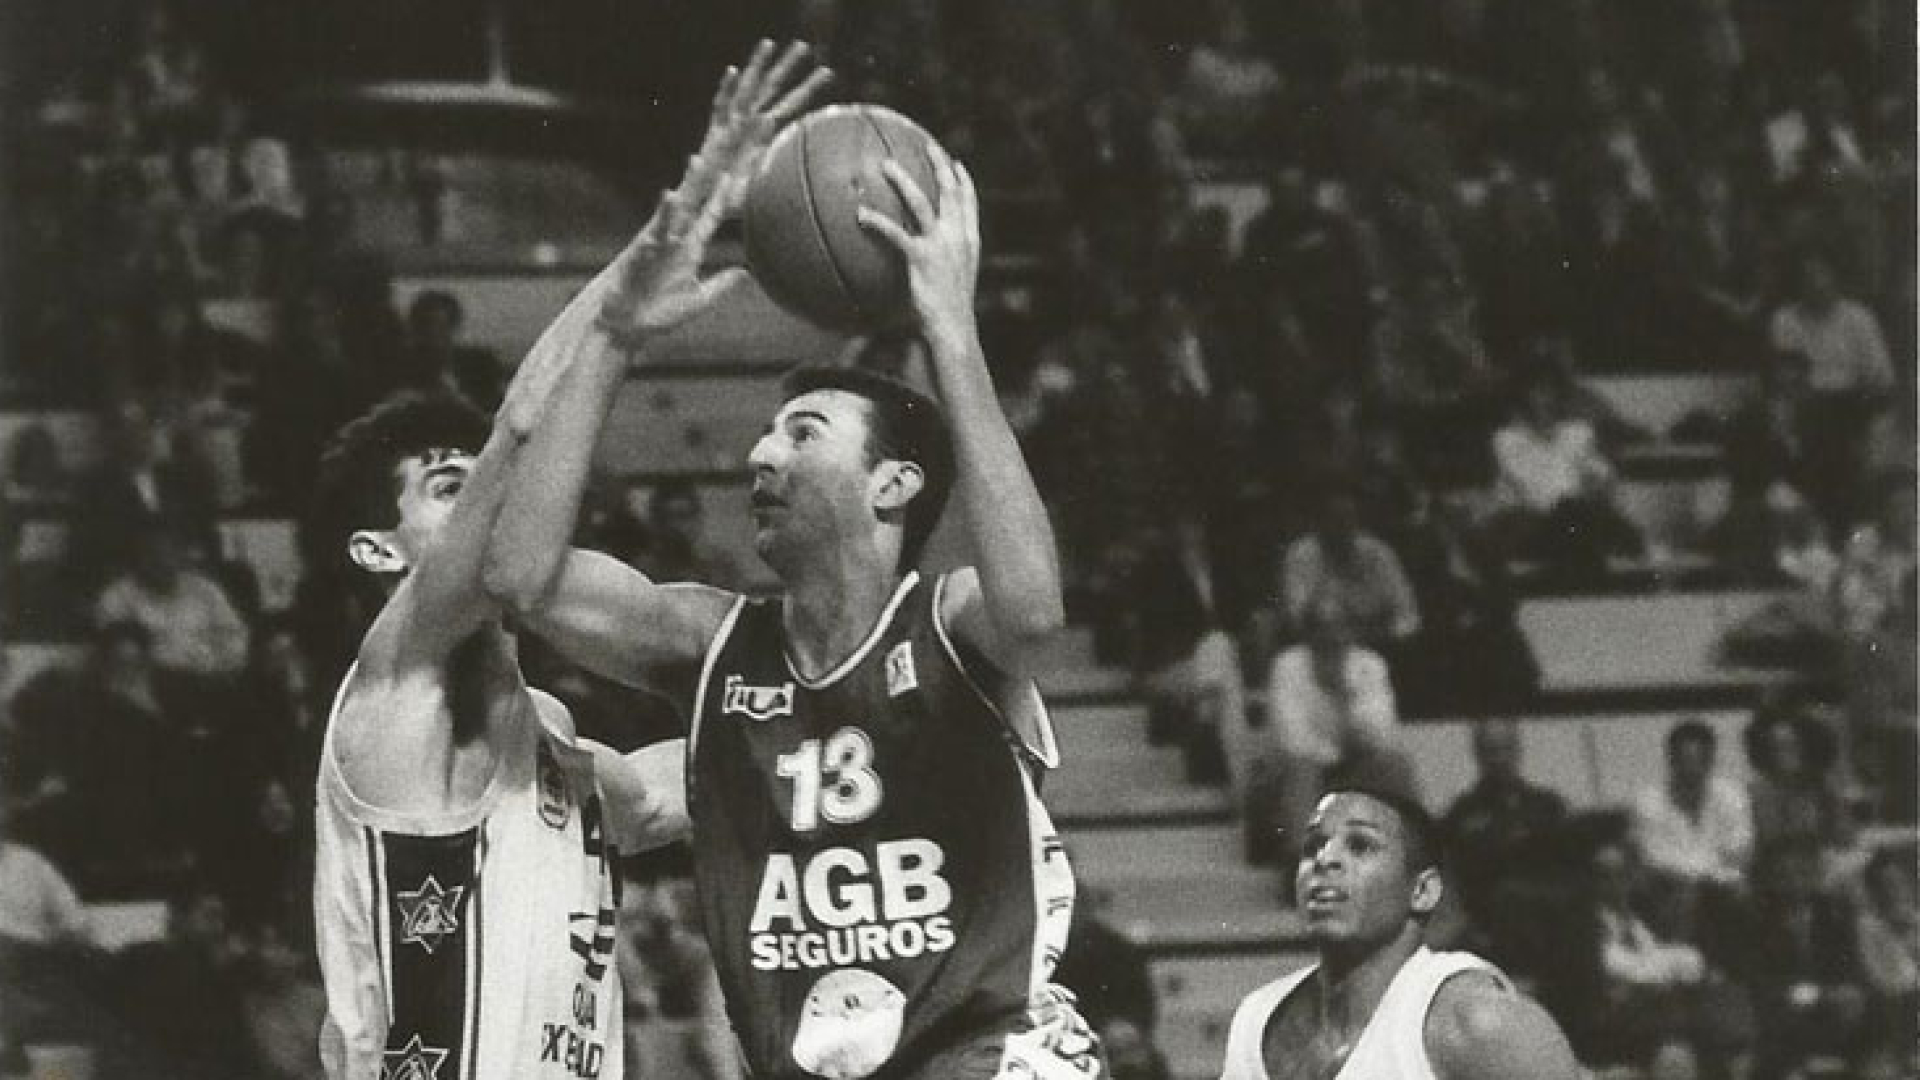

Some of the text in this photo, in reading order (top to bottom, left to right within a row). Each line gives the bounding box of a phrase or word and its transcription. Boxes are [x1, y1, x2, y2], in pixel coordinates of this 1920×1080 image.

[776, 726, 884, 832] 13
[749, 838, 952, 933] AGB
[751, 916, 956, 970] SEGUROS
